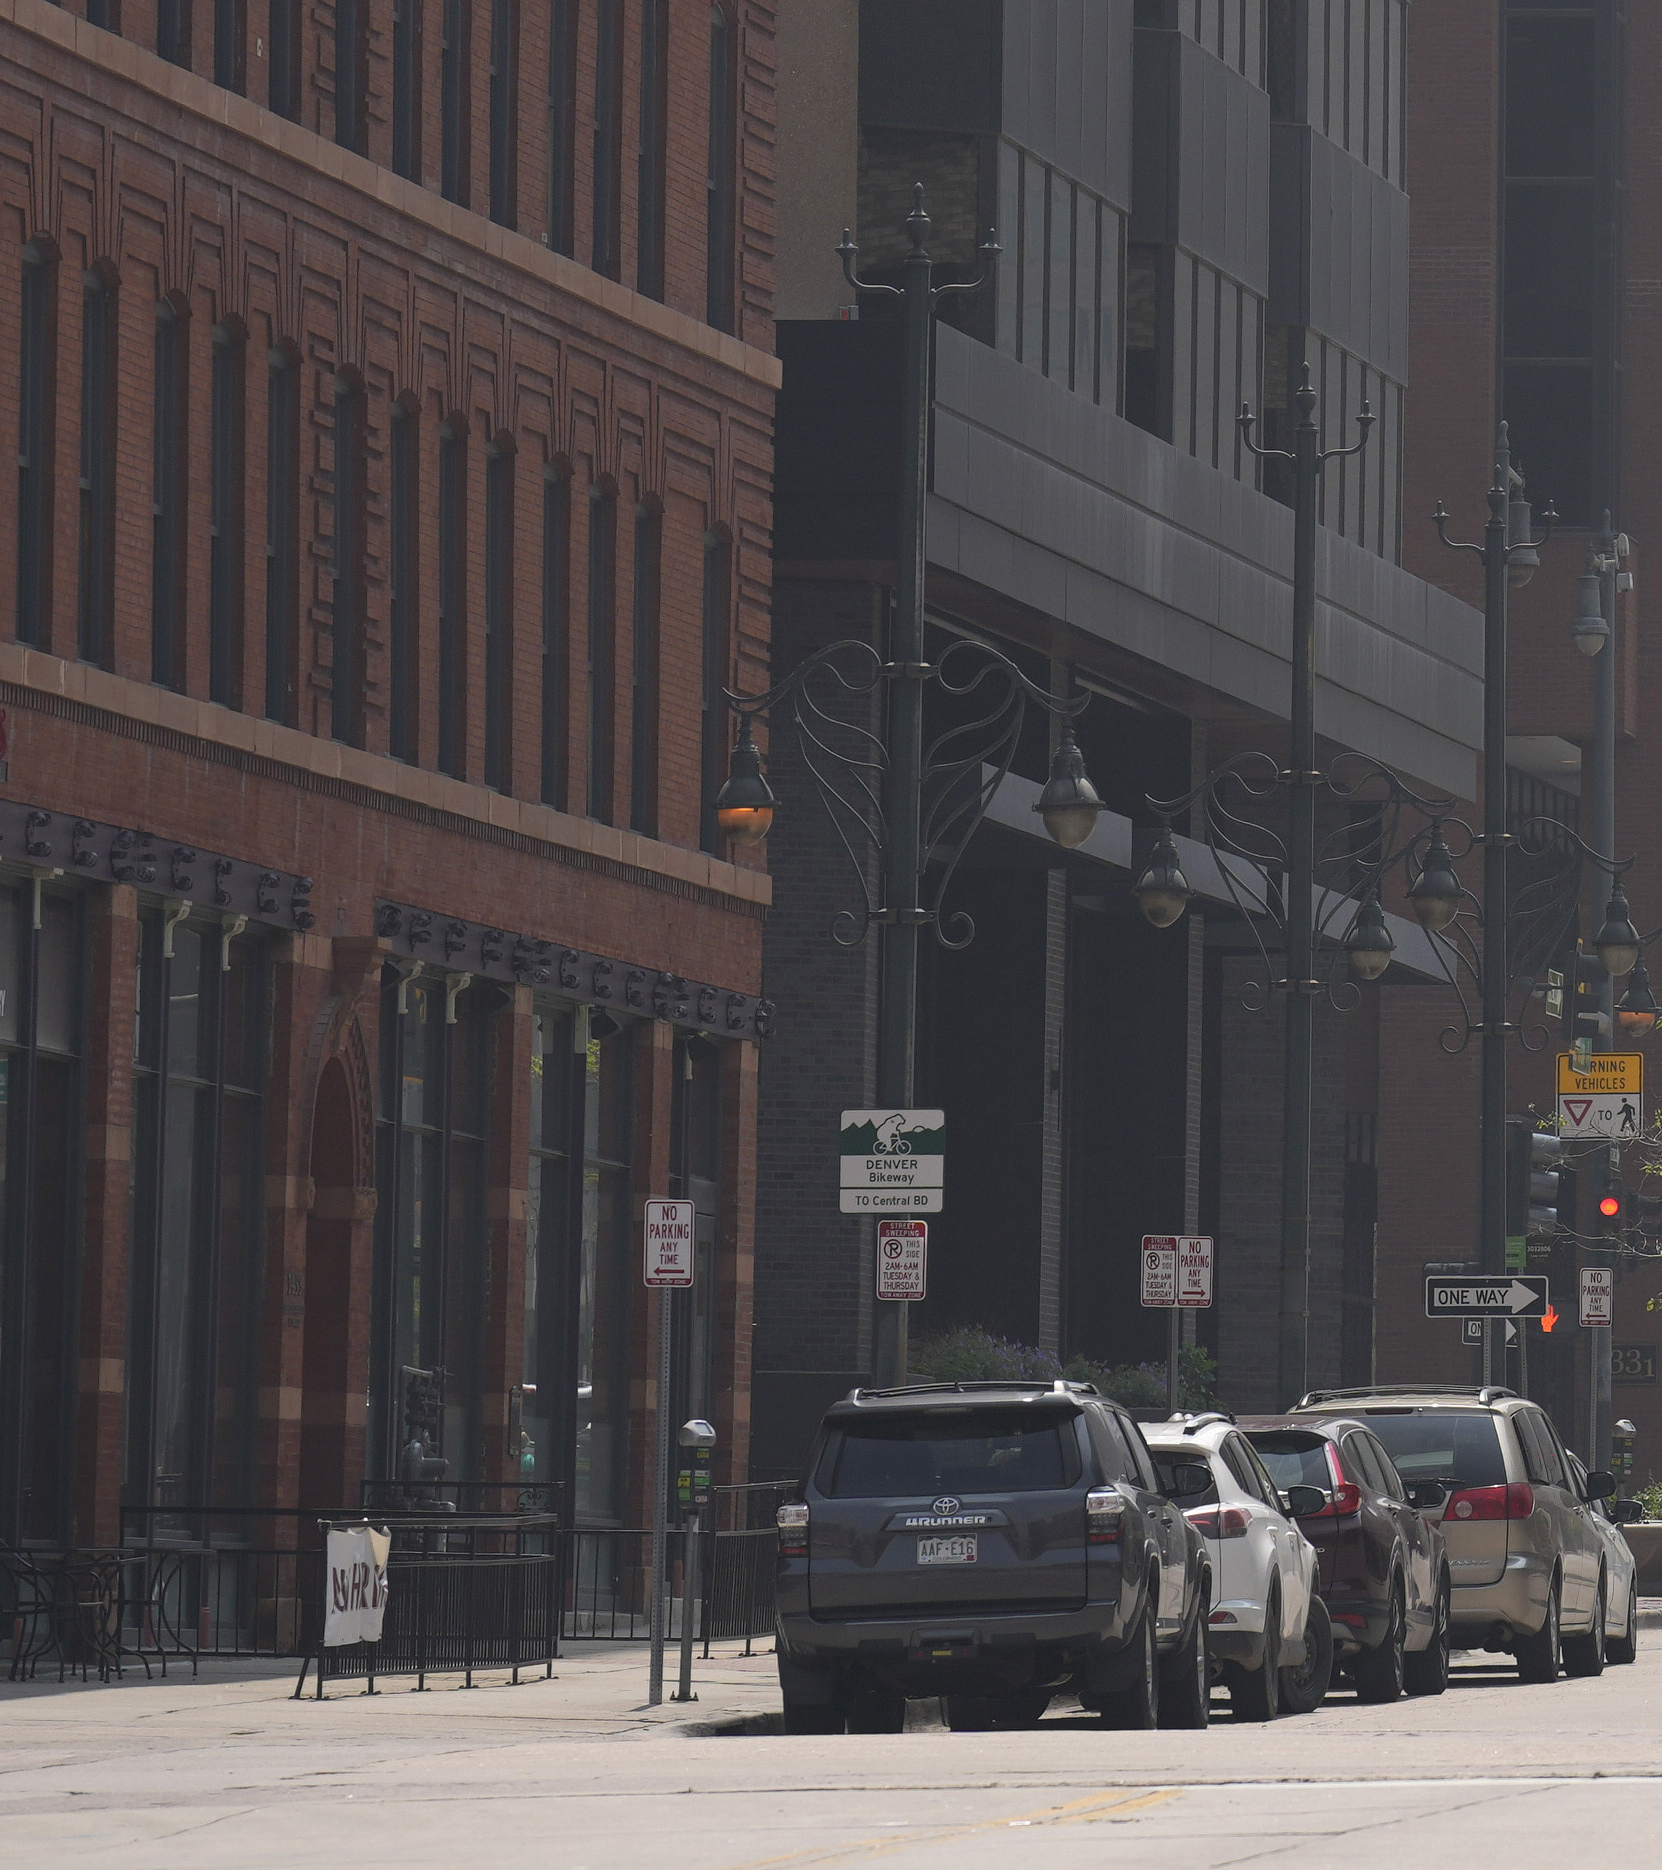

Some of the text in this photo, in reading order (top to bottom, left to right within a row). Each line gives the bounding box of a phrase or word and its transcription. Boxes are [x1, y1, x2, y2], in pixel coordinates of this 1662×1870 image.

[1591, 1060, 1626, 1074] RNING
[1575, 1077, 1626, 1090] VEHICLES
[1598, 1110, 1613, 1121] TO
[866, 1160, 918, 1170] DENVER
[869, 1172, 914, 1185] Bikeway
[855, 1195, 928, 1206] TO Central BD
[662, 1206, 677, 1221] NO
[650, 1224, 689, 1239] PARKING
[660, 1242, 677, 1252] ANY
[1189, 1241, 1201, 1254] NO
[659, 1254, 679, 1264] TIME
[906, 1250, 920, 1259] SIDE
[885, 1262, 919, 1271] 2AM-6AM
[1180, 1255, 1209, 1268] PARKING
[883, 1272, 912, 1280] TUESDAY
[1188, 1269, 1201, 1278] ANY
[1590, 1273, 1603, 1284] NO
[883, 1282, 920, 1290] THURSDAY
[1188, 1279, 1201, 1288] TIME
[1582, 1285, 1610, 1296] PARKING
[1438, 1290, 1508, 1304] ONE WAY
[1590, 1297, 1602, 1305] ANY
[1589, 1305, 1603, 1313] TIME
[906, 1516, 986, 1527] 4RUNNER
